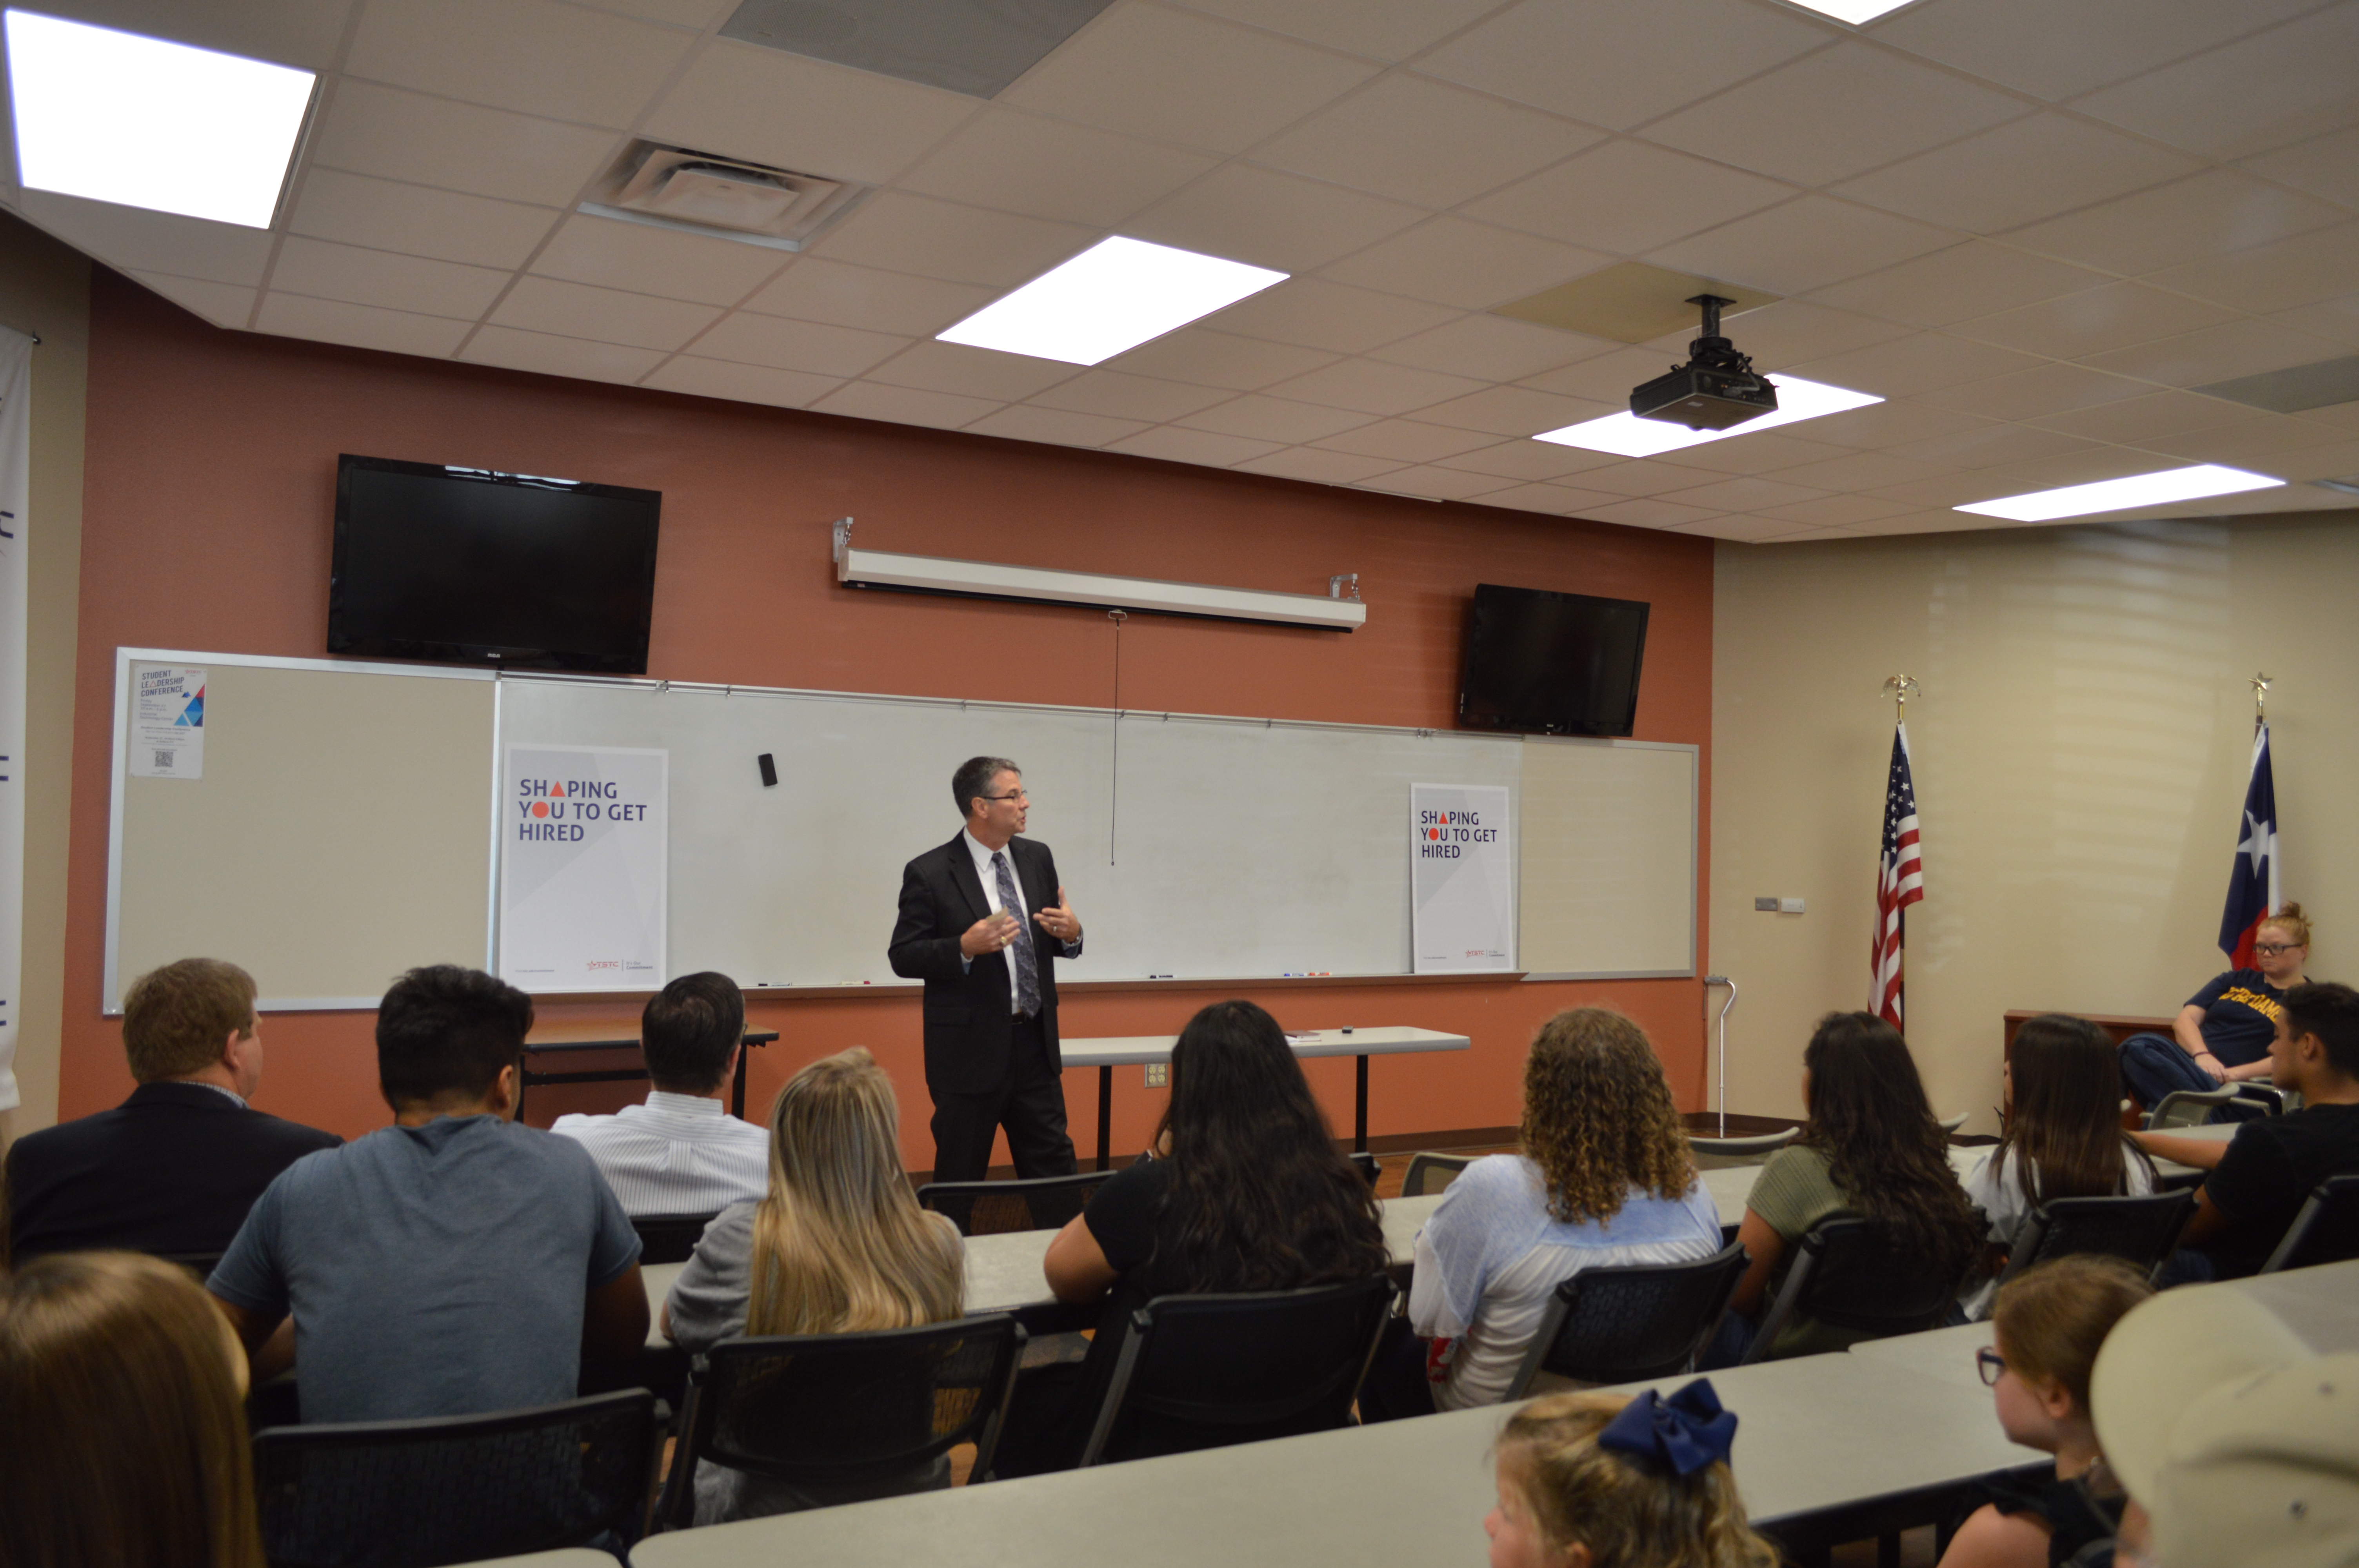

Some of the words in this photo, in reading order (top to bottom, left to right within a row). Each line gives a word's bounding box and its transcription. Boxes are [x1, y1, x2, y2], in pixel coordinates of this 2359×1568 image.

[142, 670, 171, 680] STUDENT
[142, 677, 184, 688] LEADERSHIP
[141, 686, 183, 697] CONFERENCE
[520, 779, 617, 799] SHAPING
[519, 801, 564, 819] YOU
[573, 803, 600, 820] TO
[608, 804, 647, 821] GET
[1421, 811, 1479, 825] SHAPING
[520, 823, 584, 842] HIRED
[1421, 828, 1448, 841] YOU
[1453, 829, 1469, 842] TO
[1474, 829, 1497, 842] GET
[1422, 844, 1460, 858] HIRED
